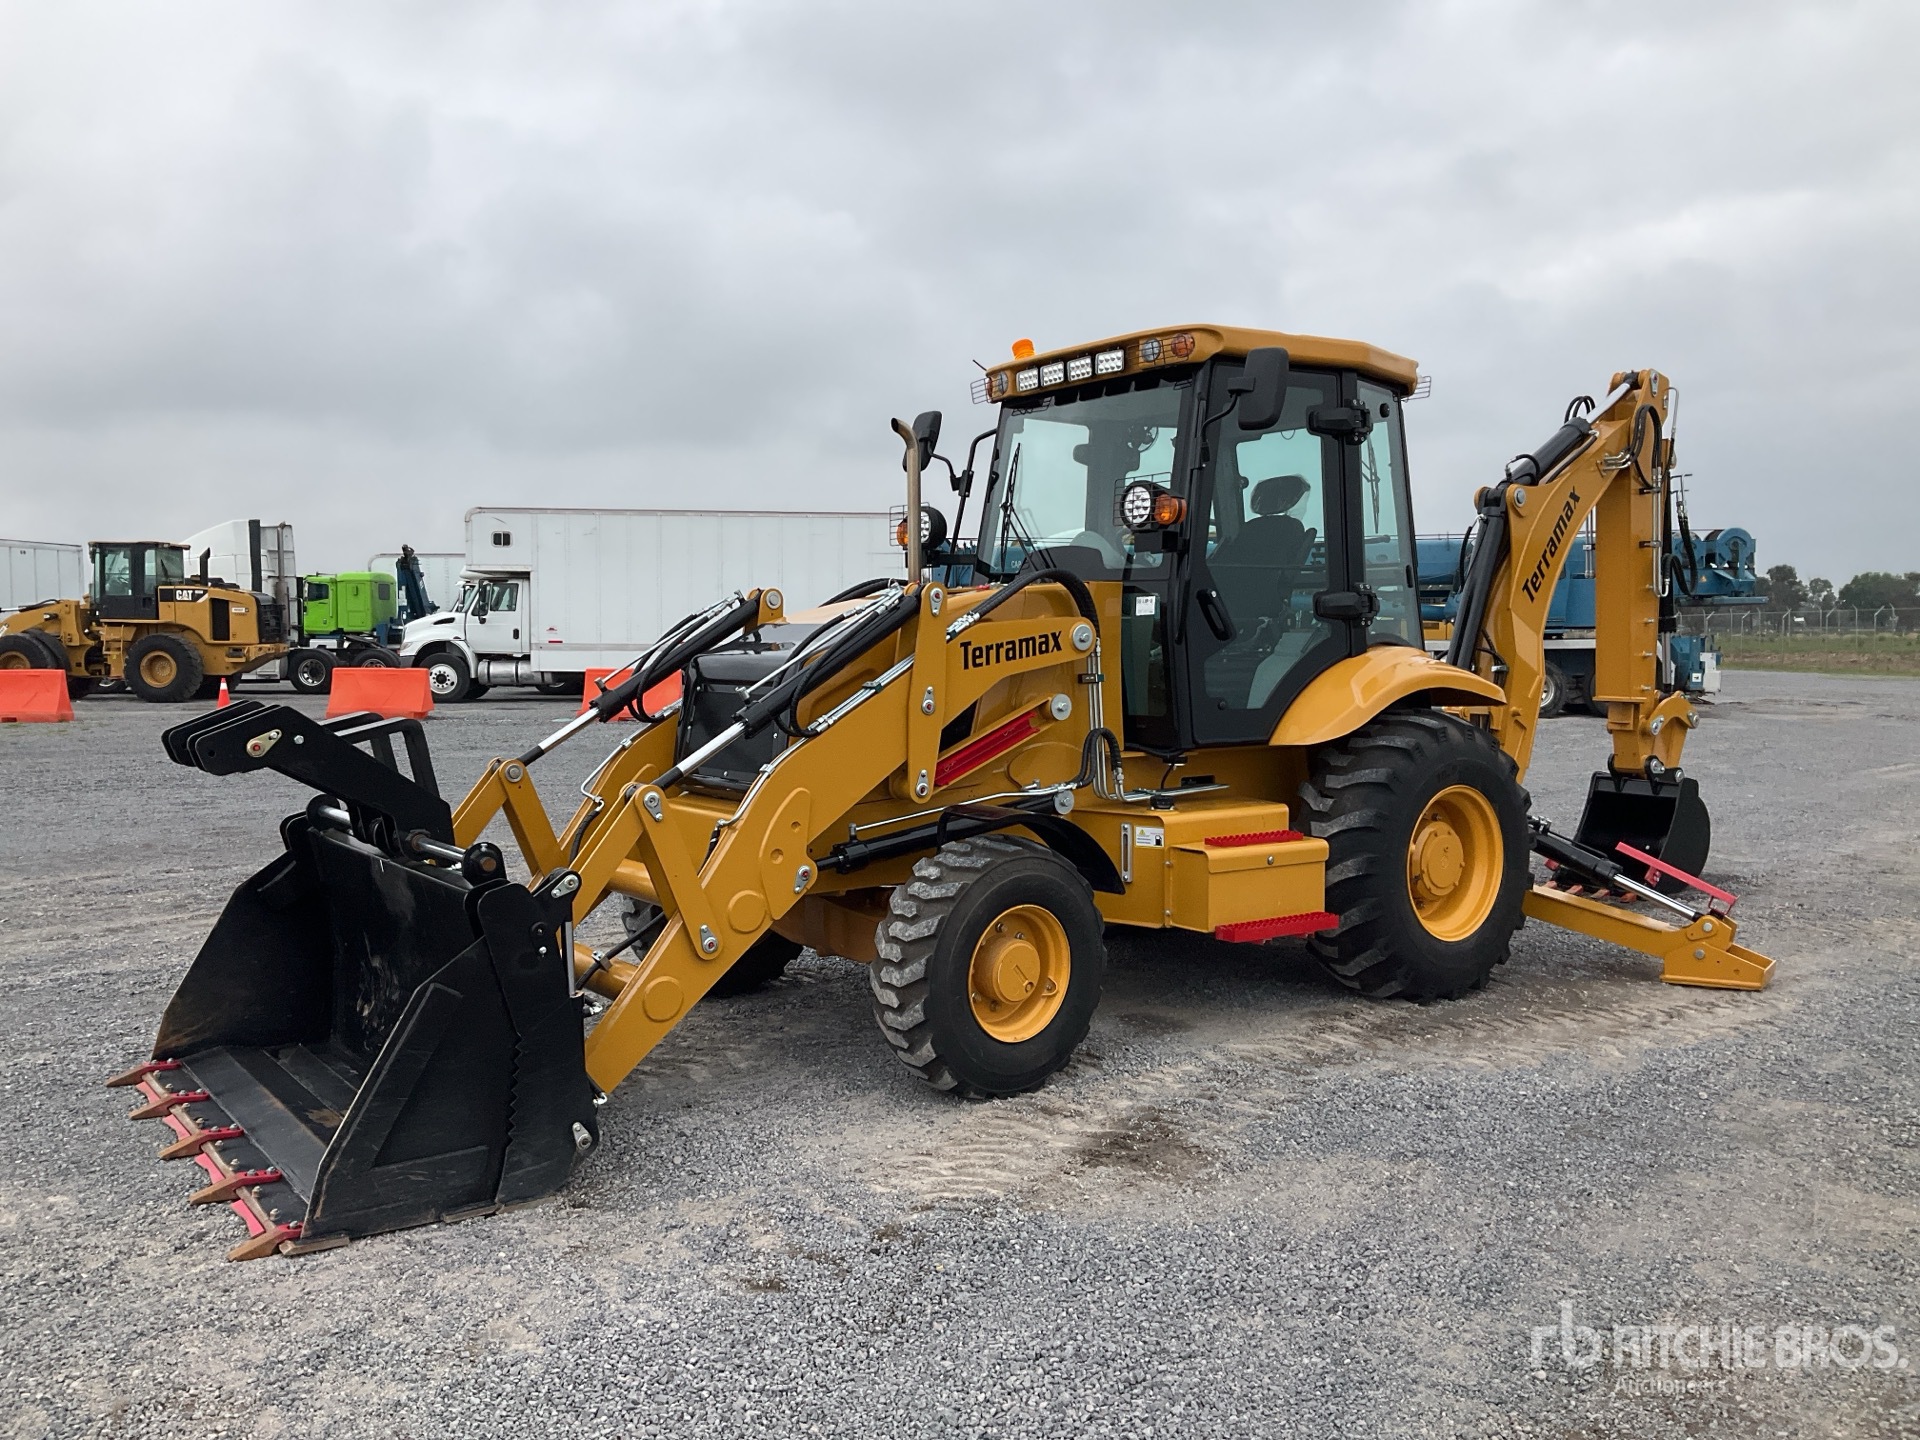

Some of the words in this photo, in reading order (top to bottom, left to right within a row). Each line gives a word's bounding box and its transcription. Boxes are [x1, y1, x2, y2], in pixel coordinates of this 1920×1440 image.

[1522, 486, 1581, 603] Terramax
[176, 590, 193, 600] CAT
[960, 630, 1063, 670] Terramax
